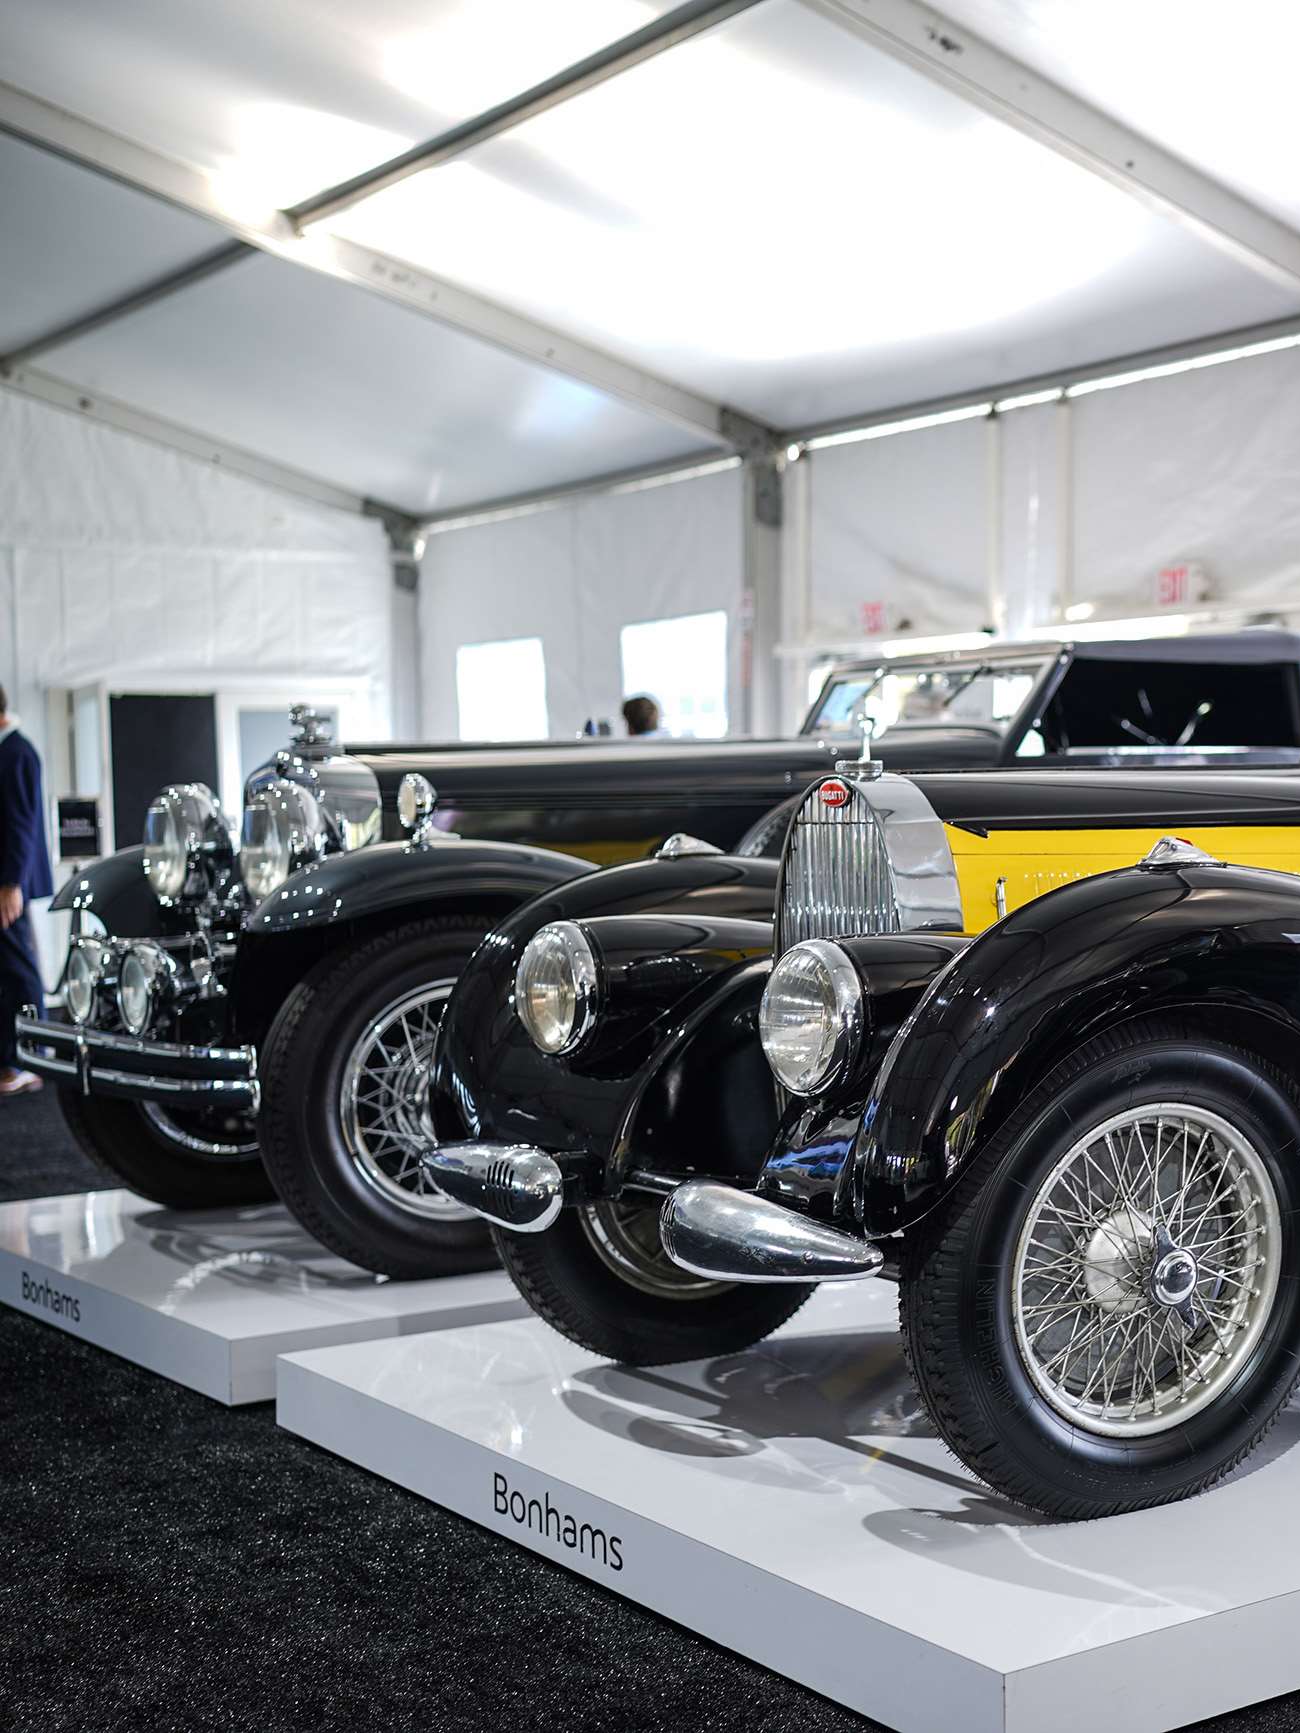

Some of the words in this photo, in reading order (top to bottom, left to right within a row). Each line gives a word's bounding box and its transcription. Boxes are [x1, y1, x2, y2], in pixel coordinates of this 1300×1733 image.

[820, 790, 845, 801] BUGATTI
[21, 1271, 81, 1323] Bonhams
[975, 1278, 1018, 1417] MICHELIN
[493, 1471, 624, 1572] Bonhams
